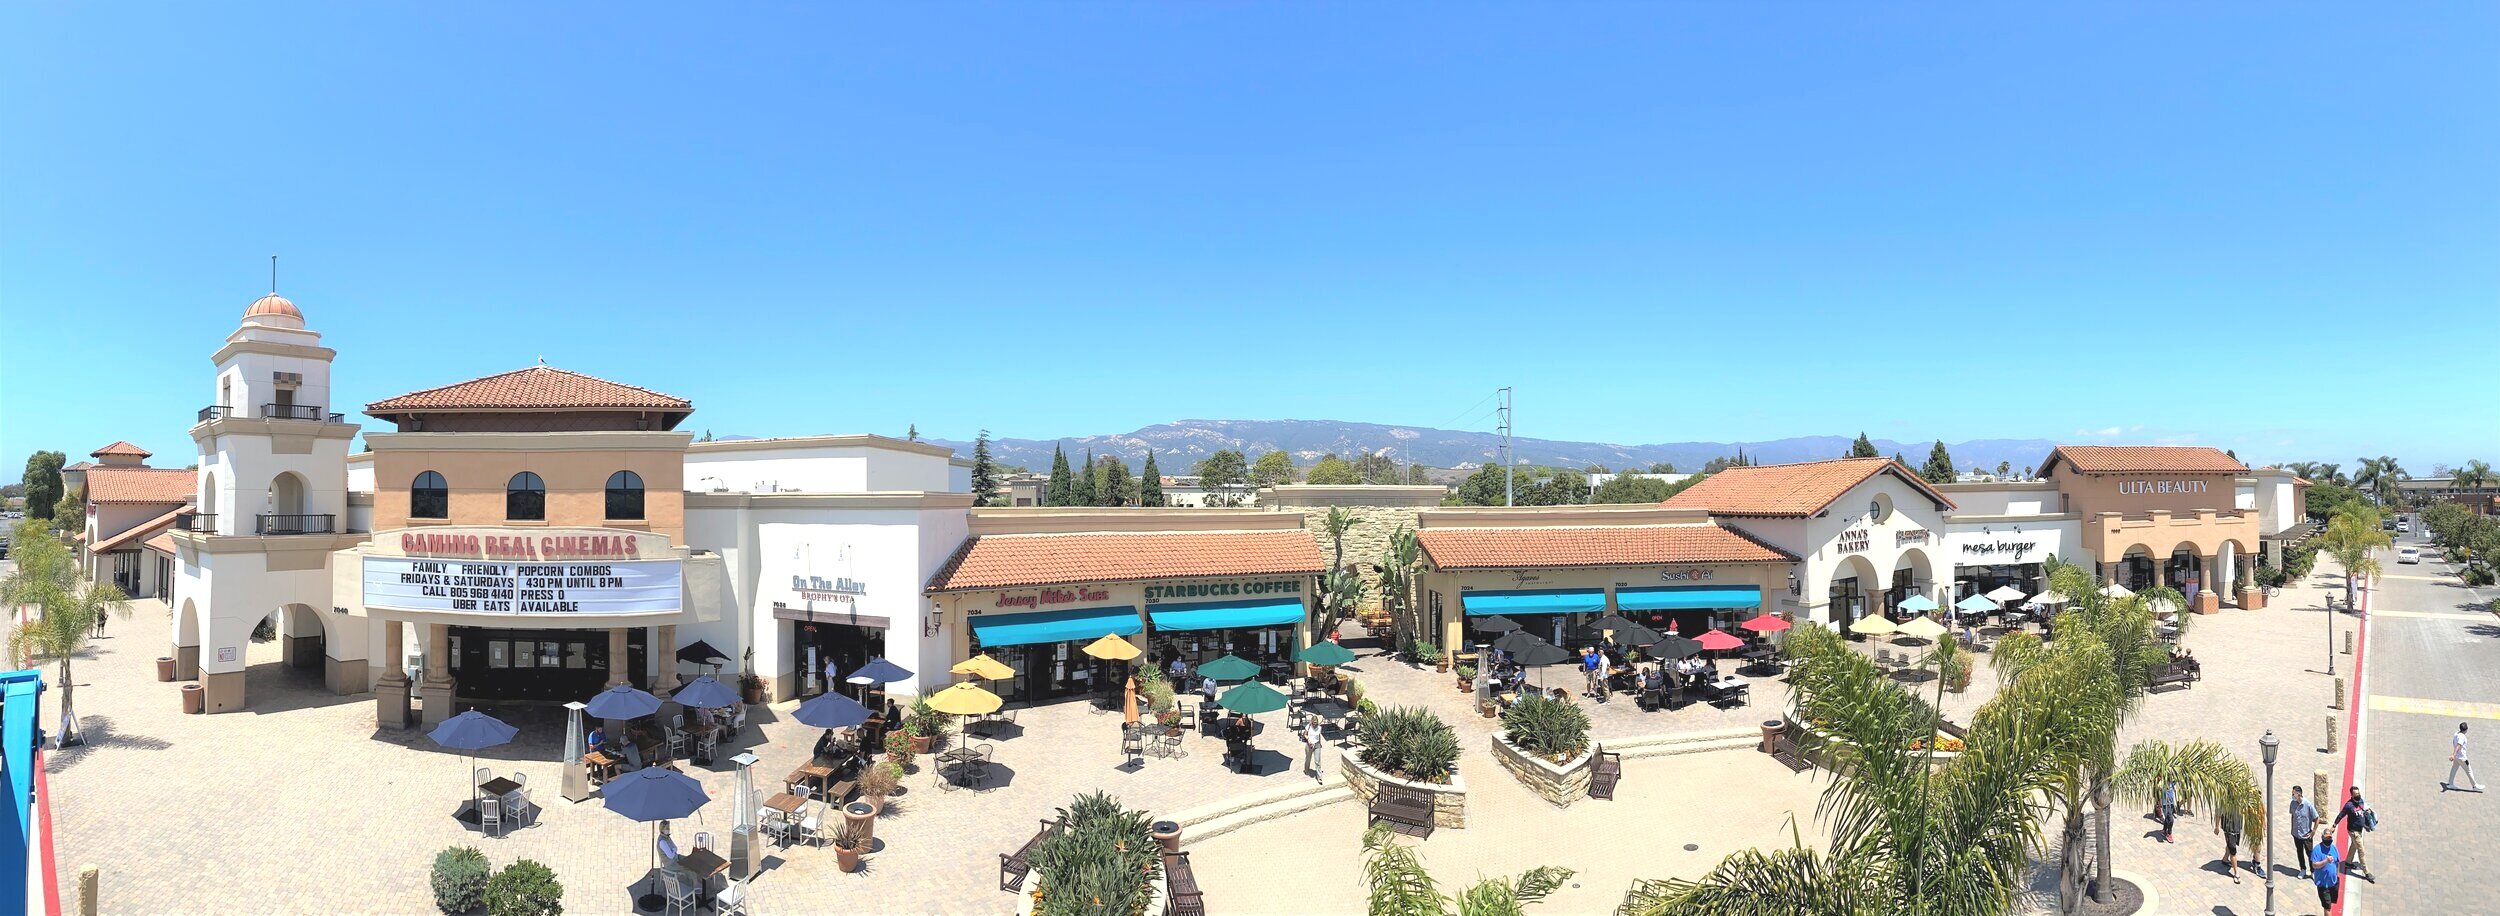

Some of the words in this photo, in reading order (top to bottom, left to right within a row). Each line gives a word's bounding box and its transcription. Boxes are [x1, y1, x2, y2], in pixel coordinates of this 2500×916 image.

[2119, 481, 2154, 495] ULTA
[2157, 480, 2209, 494] BEAUTY
[1839, 529, 1868, 542] ANNA'S
[401, 533, 479, 555] CAMINO
[485, 535, 536, 556] REAL
[541, 535, 637, 556] CINEMAS
[1837, 540, 1870, 553] BAKERY
[1962, 543, 1995, 553] mesa
[1996, 540, 2036, 560] burger
[412, 562, 447, 574] FAMILY
[461, 564, 508, 576] FRIENDLY
[518, 566, 564, 577] POPCORN
[569, 565, 611, 576] COMBOS
[1662, 570, 1689, 581] Sushi
[1701, 569, 1713, 580] Ai
[401, 573, 440, 585] FRIDAYS
[443, 576, 451, 586] &
[453, 575, 514, 588] SATURDAYS
[526, 578, 545, 588] 430
[547, 578, 563, 588] PM
[566, 577, 596, 588] UNTIL
[599, 577, 606, 588] 8
[607, 577, 623, 588] PM
[792, 575, 807, 589] On
[809, 575, 832, 590] The
[835, 577, 866, 594] Alley
[422, 586, 447, 597] CALL
[450, 588, 468, 598] 805
[470, 588, 489, 599] 968
[491, 588, 514, 600] 4140
[520, 589, 554, 600] PRESS
[1144, 582, 1240, 599] STARBUCKS
[1243, 580, 1301, 595] COFFEE
[453, 599, 477, 610] UBER
[483, 601, 510, 612] EATS
[520, 602, 579, 613] AVAILABLE
[995, 593, 1038, 609] Jersey
[1040, 590, 1077, 605] Mike's
[333, 606, 349, 615] 7040
